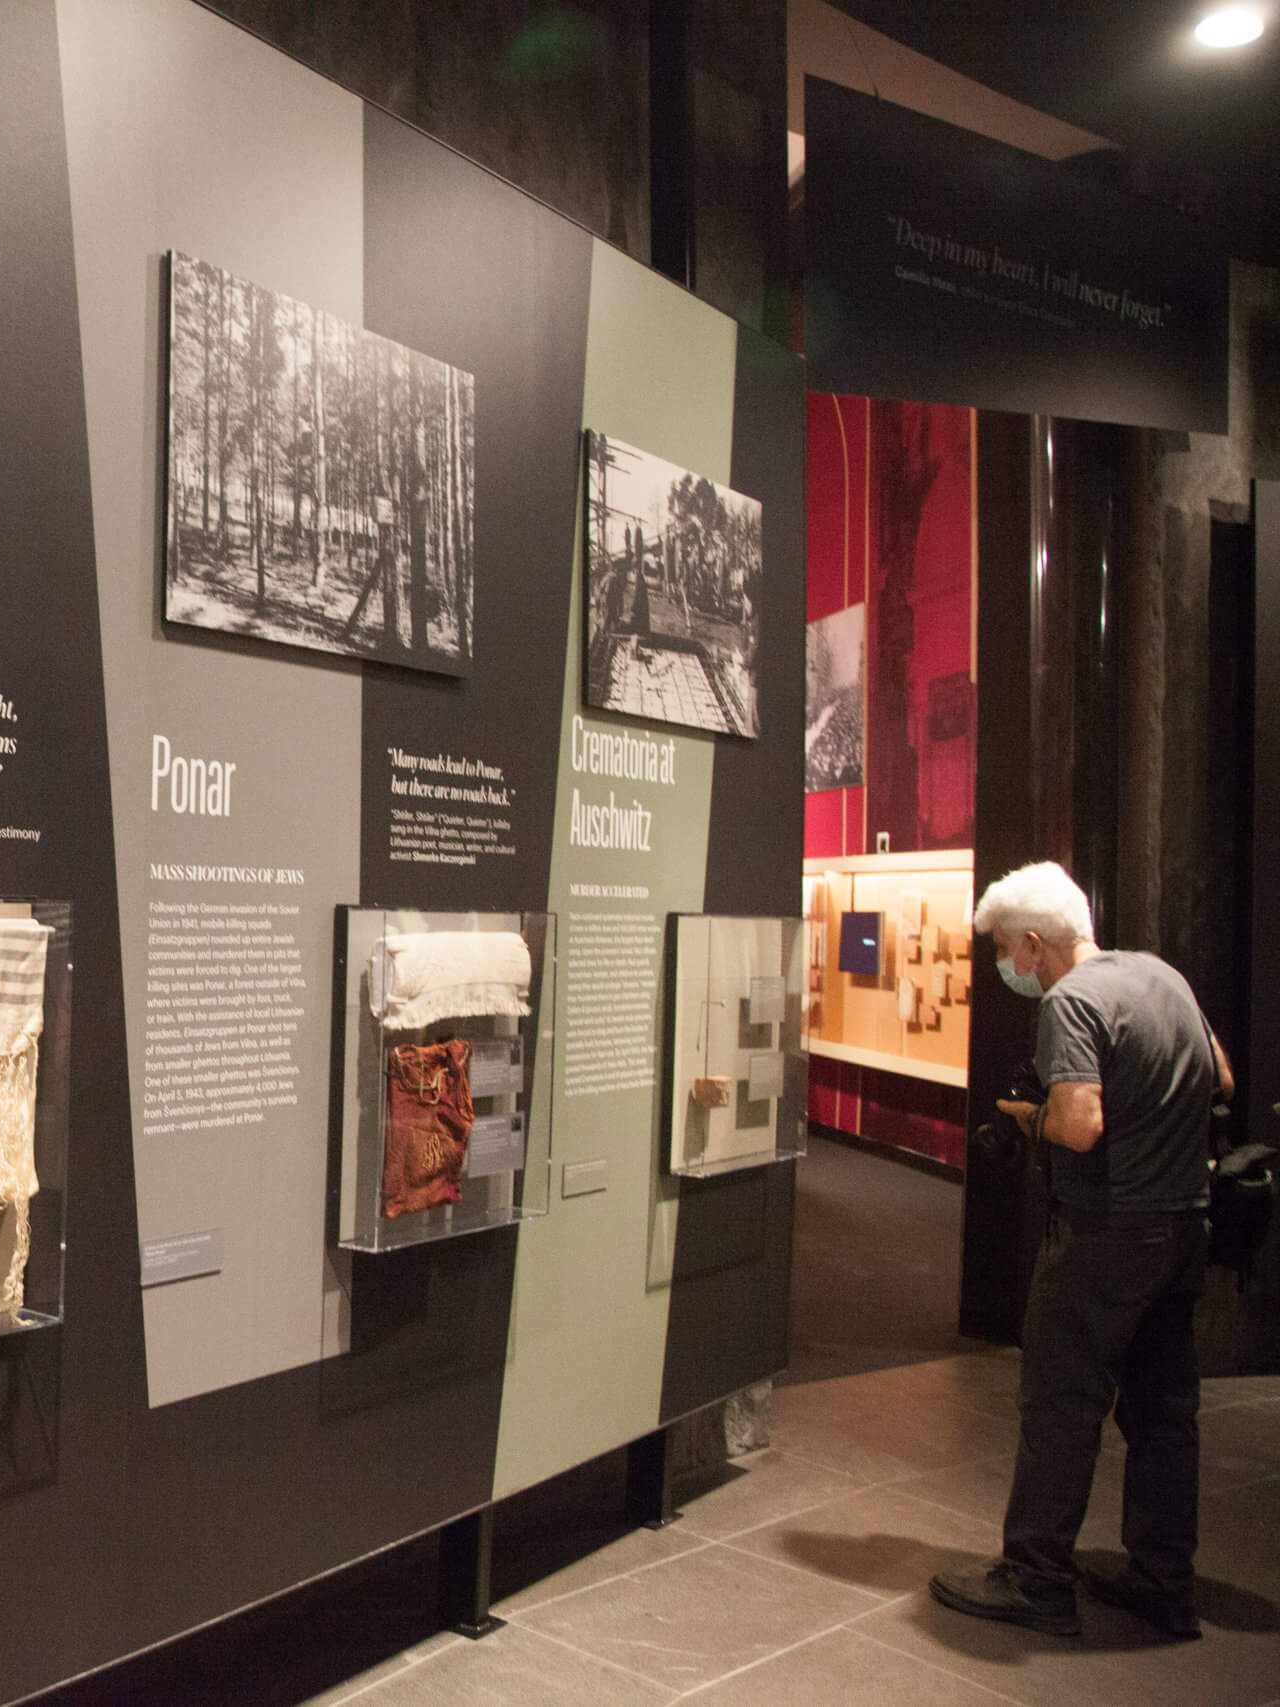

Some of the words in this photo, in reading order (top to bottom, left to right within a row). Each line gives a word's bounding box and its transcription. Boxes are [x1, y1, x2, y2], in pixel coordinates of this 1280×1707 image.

[944, 233, 962, 263] in
[964, 245, 989, 276] my
[1052, 271, 1080, 298] will
[1079, 283, 1119, 312] never
[151, 734, 237, 817] Ponar
[571, 714, 658, 783] Crematoria
[659, 738, 676, 785] at
[570, 788, 652, 851] Auschwitz
[150, 863, 184, 881] MASS
[185, 865, 257, 883] SHOOTINGS
[258, 867, 273, 884] OF
[274, 868, 305, 885] JEWS
